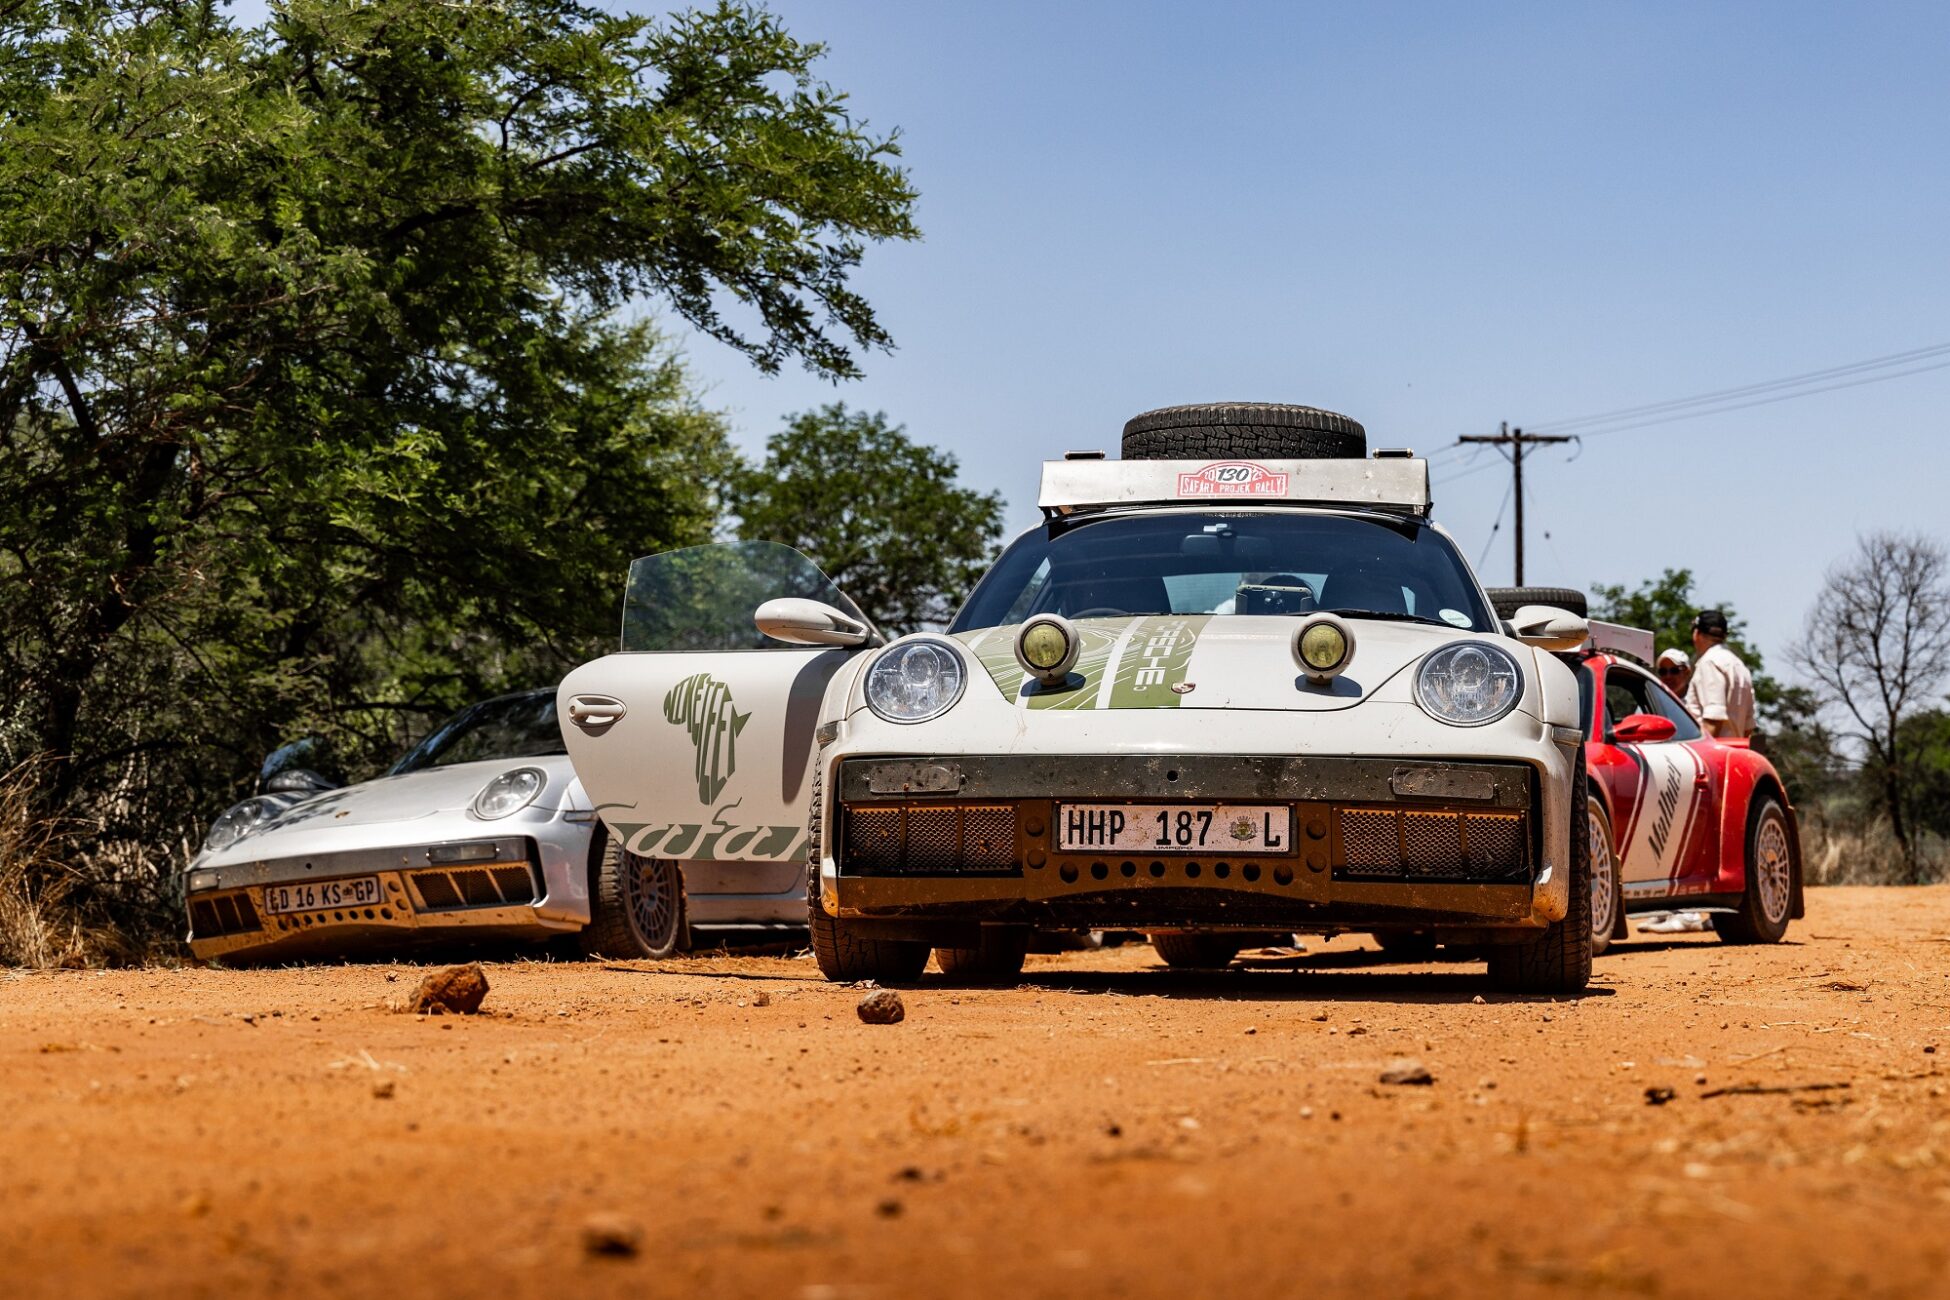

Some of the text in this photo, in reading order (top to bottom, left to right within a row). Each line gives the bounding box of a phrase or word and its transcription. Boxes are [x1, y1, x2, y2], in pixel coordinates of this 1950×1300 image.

[1183, 477, 1282, 494] SAFARI PROJEK RALLY
[1217, 467, 1250, 482] 130
[1067, 809, 1281, 847] HHP 187 L
[296, 886, 315, 908] 16
[321, 883, 342, 905] KS
[355, 880, 374, 902] GP
